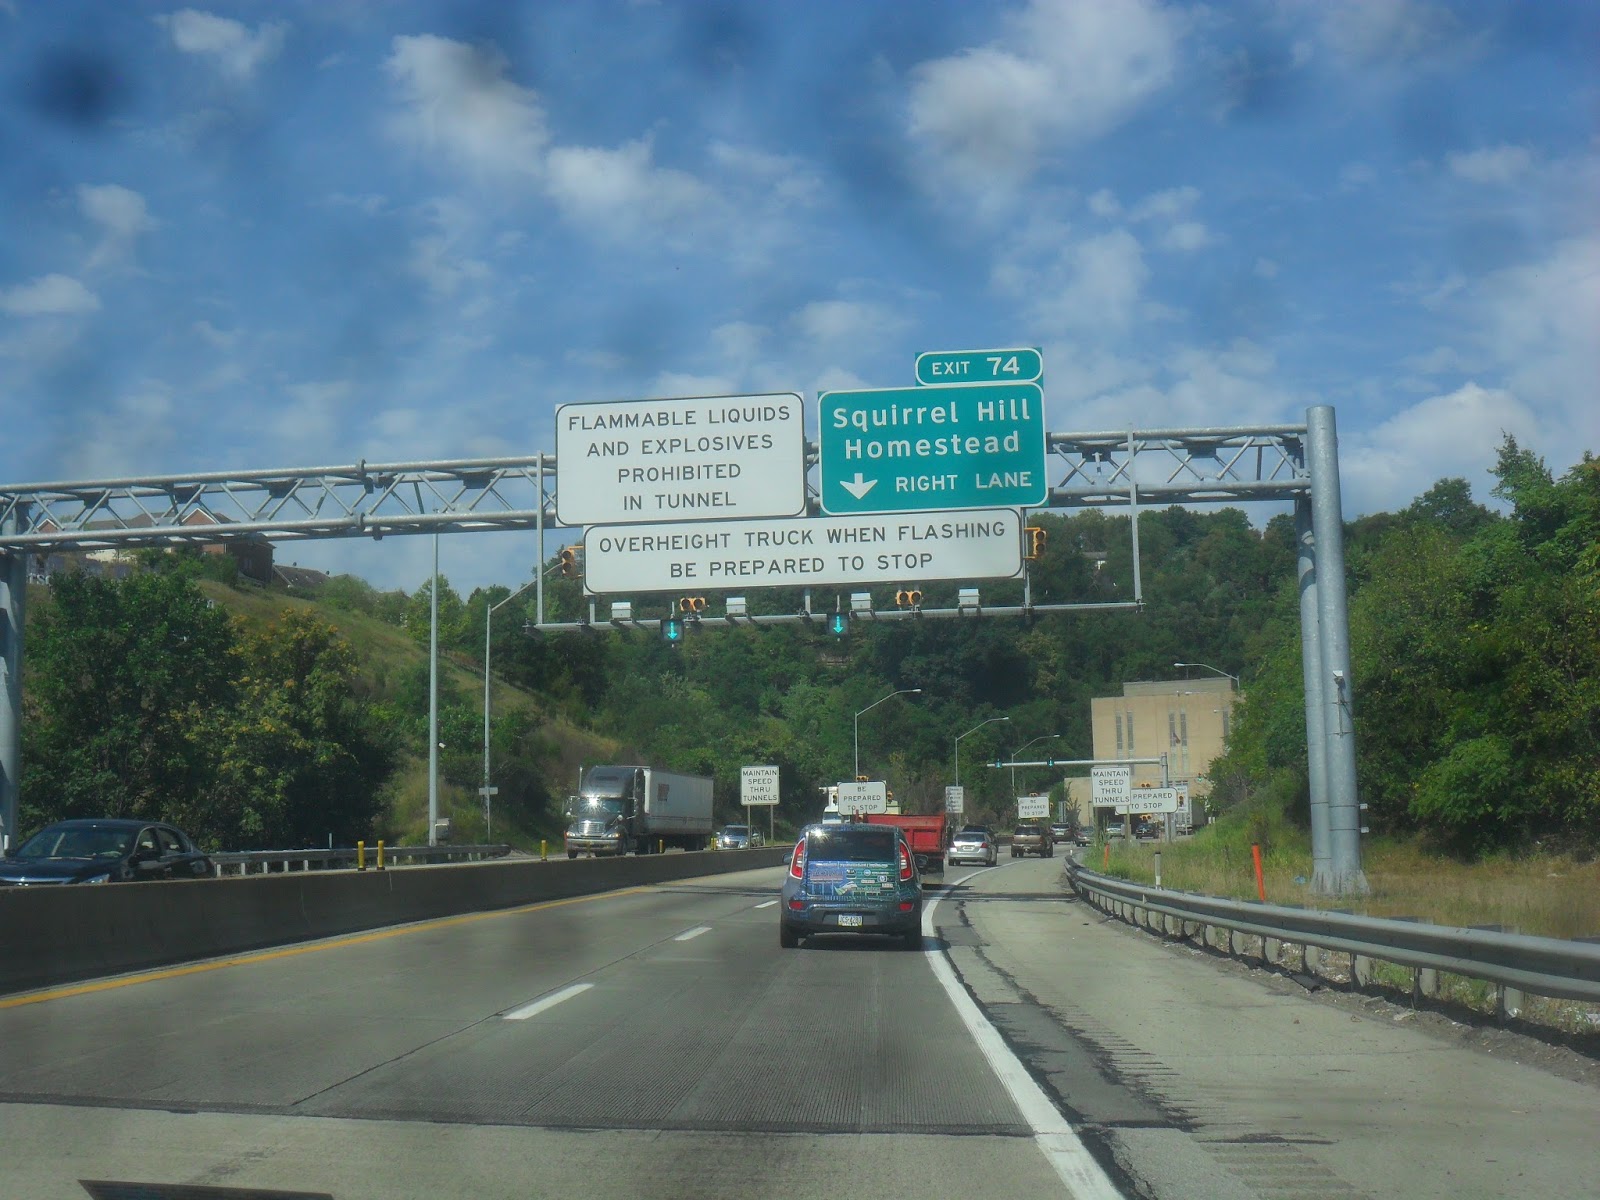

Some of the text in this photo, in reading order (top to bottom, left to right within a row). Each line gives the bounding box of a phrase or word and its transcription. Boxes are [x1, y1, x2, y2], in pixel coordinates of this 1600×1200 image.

[932, 356, 1020, 376] EXIT 74
[569, 405, 790, 431] FLAMMABLE LIQUIDS
[833, 398, 1030, 433] Squirrel Hill
[587, 434, 773, 457] AND EXPLOSIVES
[845, 430, 1019, 460] Homestead
[618, 463, 741, 483] PROHIBITED
[896, 471, 1032, 493] RIGHT LANE
[623, 491, 736, 511] IN TUNNEL
[599, 521, 1005, 553] OVERHEIGHT TRUCK WHEN FLASHING
[670, 553, 933, 578] BE PREPARED TO STOP
[743, 769, 777, 777] MAINTAIN
[843, 794, 882, 802] PREPARED
[1101, 787, 1123, 795] THRU
[1132, 792, 1173, 800] PREPARED
